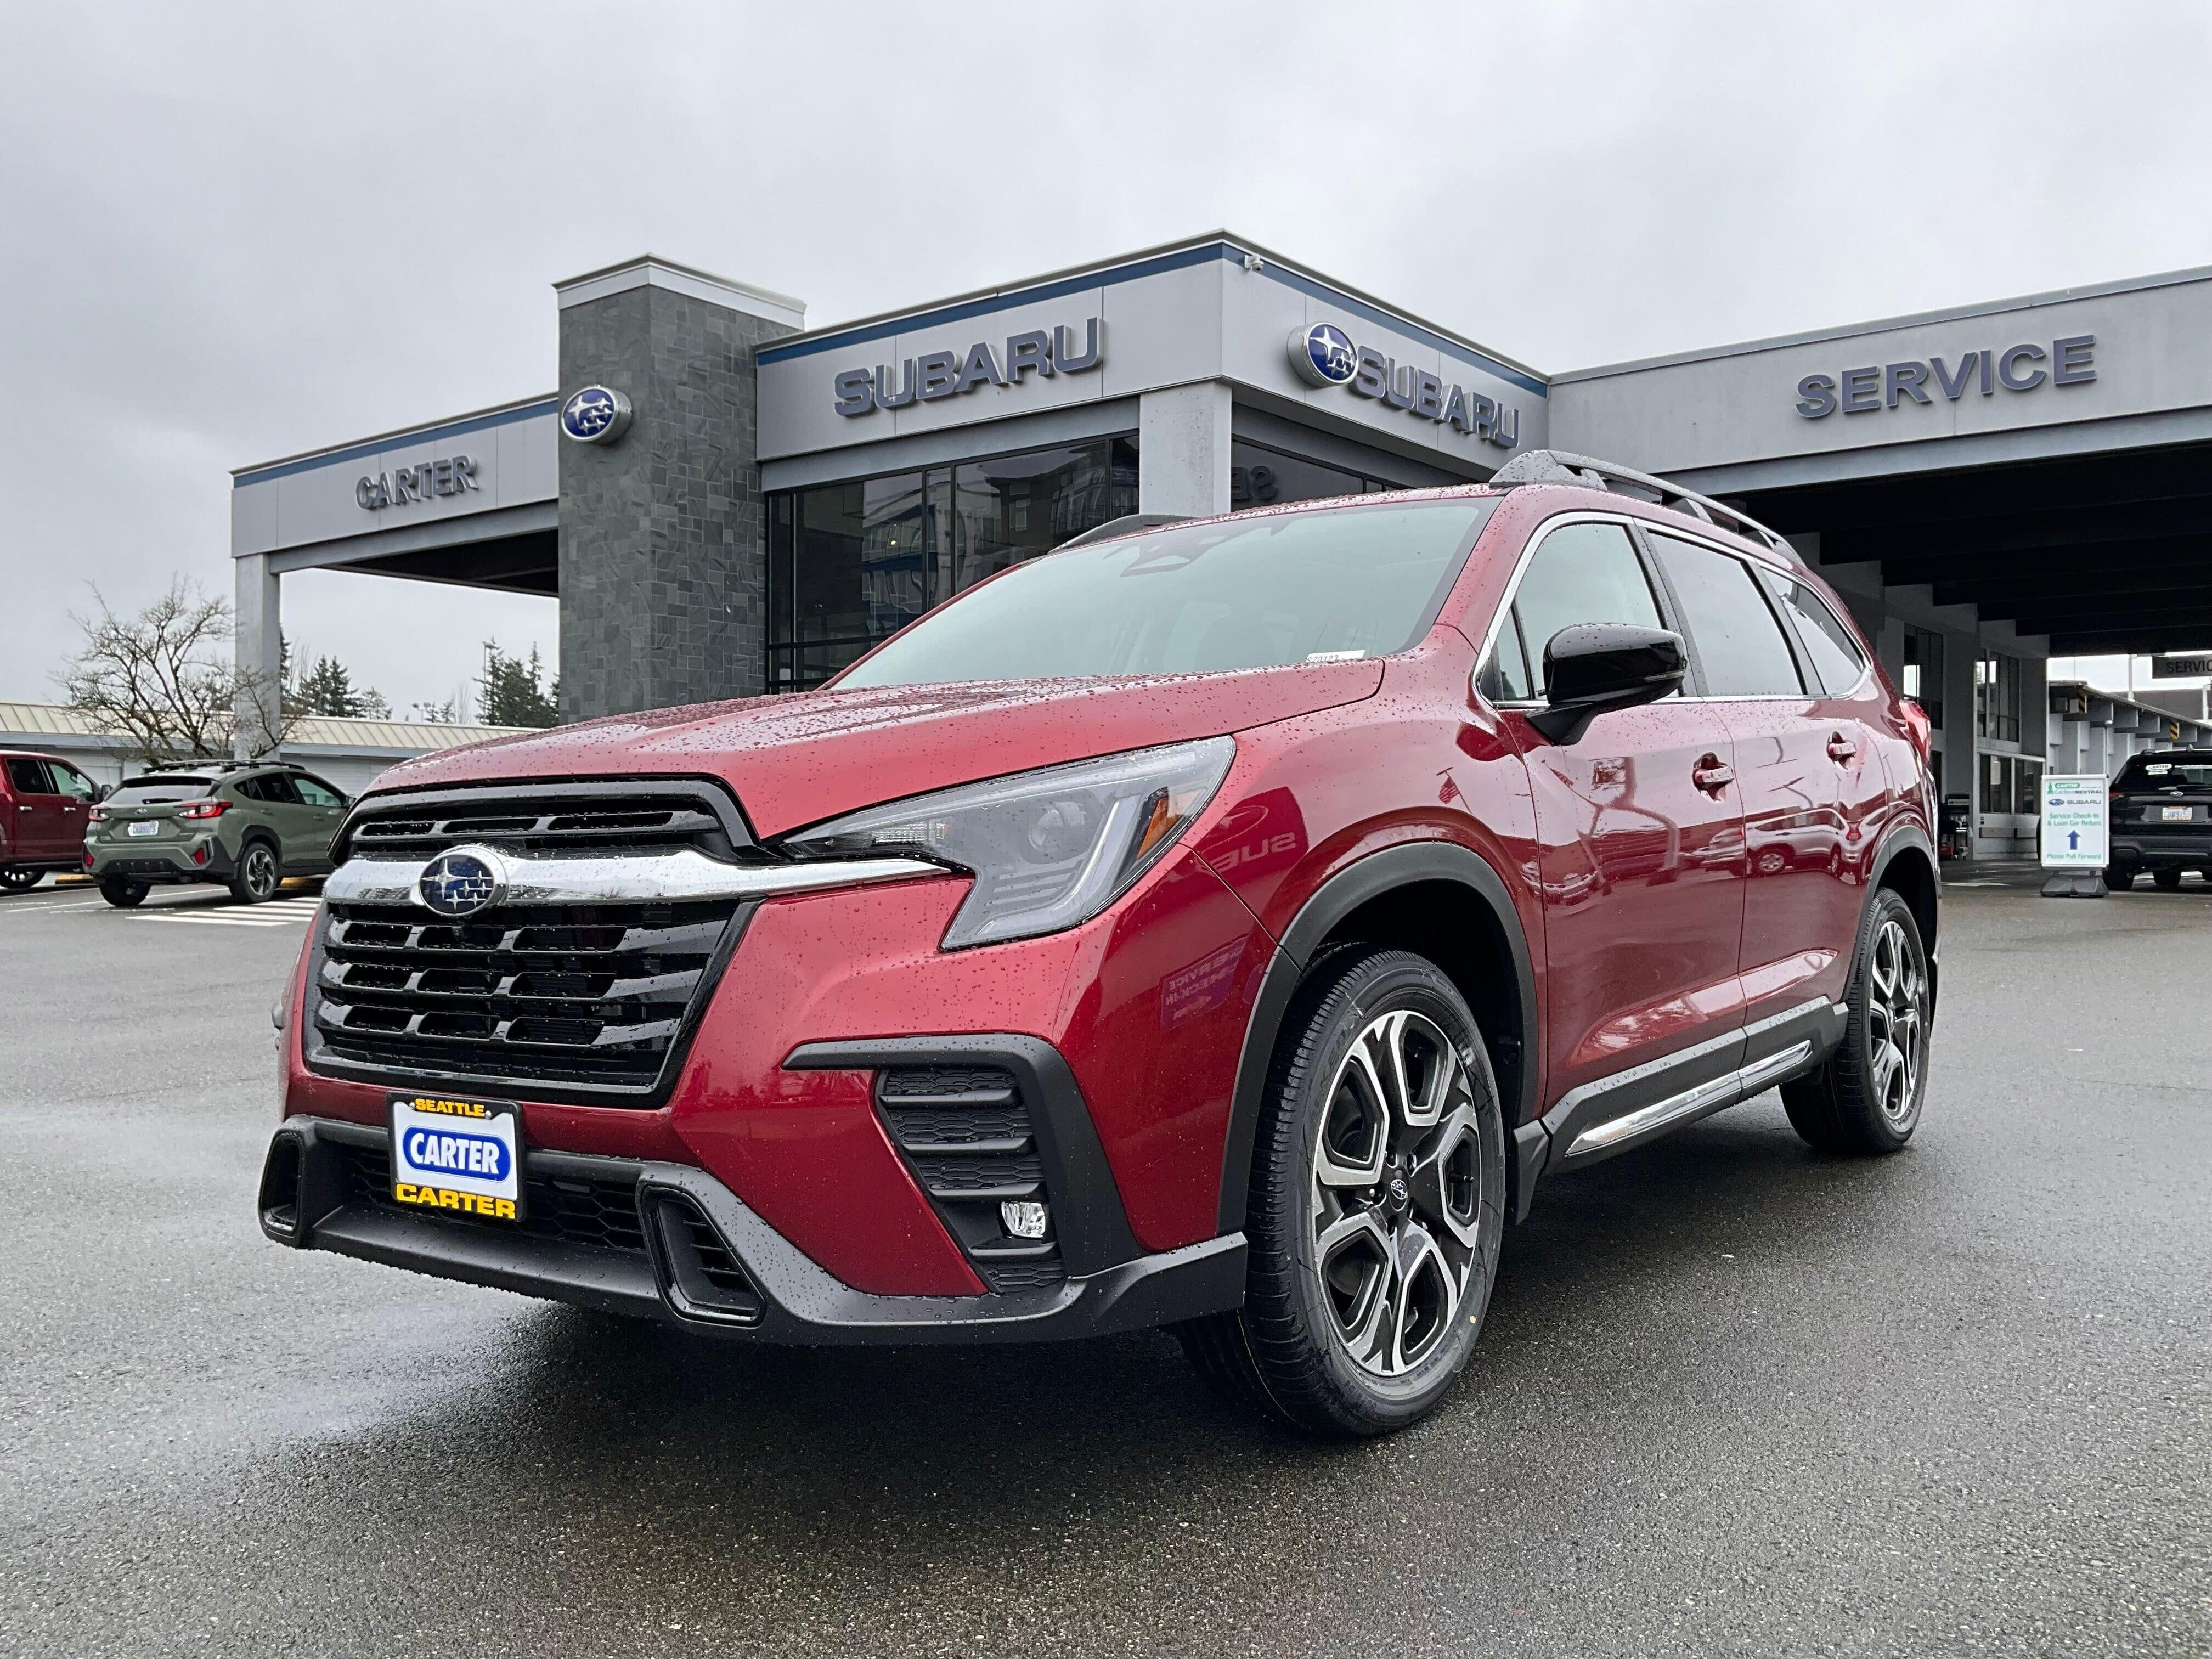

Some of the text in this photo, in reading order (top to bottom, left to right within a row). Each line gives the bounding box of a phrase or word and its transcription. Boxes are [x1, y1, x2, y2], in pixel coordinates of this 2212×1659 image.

[834, 317, 1104, 416] SUBARU
[1795, 335, 2097, 419] SERVICE
[1351, 345, 1520, 449] SUBARU
[356, 455, 478, 510] CARTER
[415, 1098, 486, 1117] SEATTLE
[410, 1132, 499, 1174] CARTER
[396, 1183, 515, 1220] CARTER
